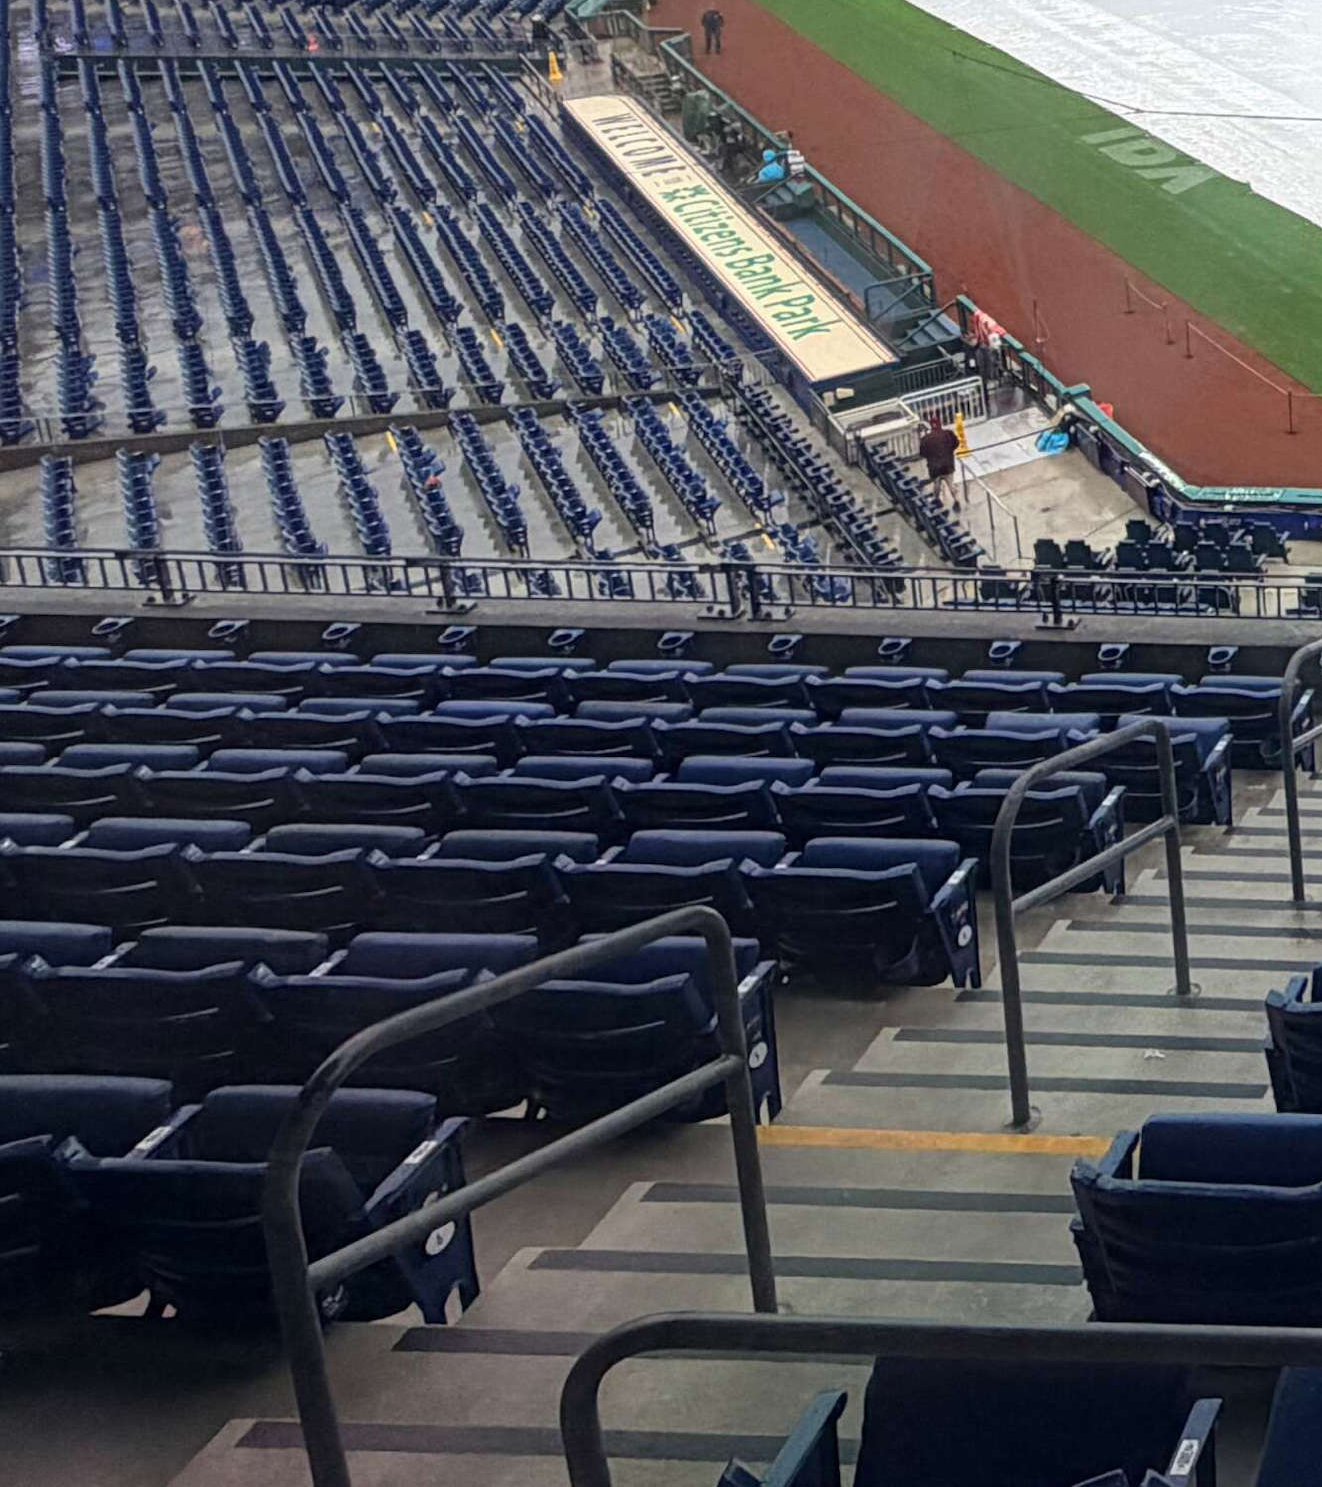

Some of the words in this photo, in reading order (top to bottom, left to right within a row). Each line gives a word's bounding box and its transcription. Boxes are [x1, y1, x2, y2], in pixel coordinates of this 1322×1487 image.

[592, 112, 689, 178] WELCOME
[672, 195, 752, 266] Citizens
[724, 253, 803, 302] Bank
[771, 293, 842, 342] Park
